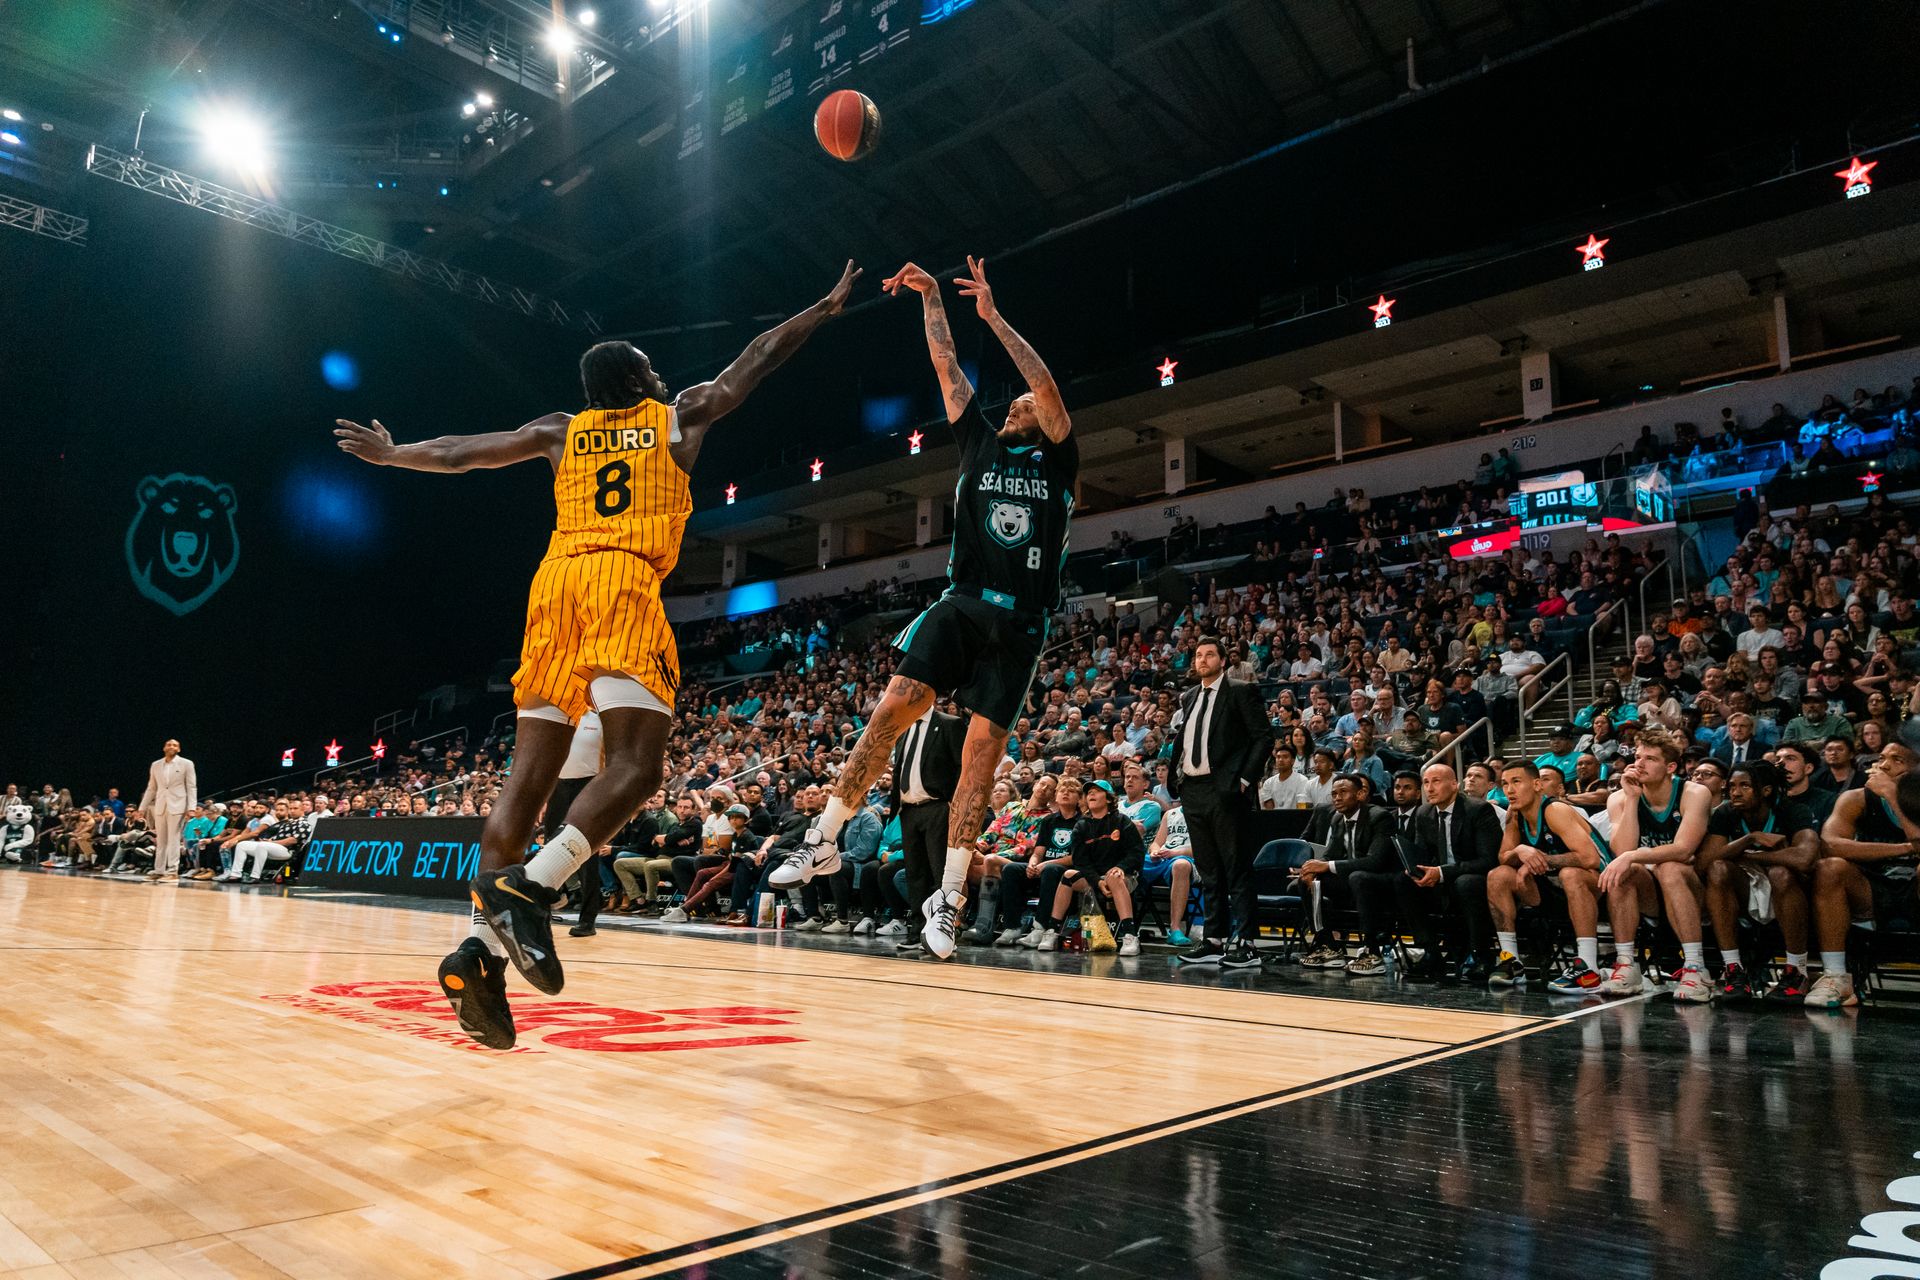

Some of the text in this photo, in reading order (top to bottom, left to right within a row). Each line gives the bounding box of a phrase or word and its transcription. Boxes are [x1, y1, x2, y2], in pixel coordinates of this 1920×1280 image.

[878, 13, 889, 33] 4
[821, 44, 836, 69] 14
[574, 428, 655, 455] ODURO
[1512, 435, 1536, 450] 219
[594, 460, 631, 518] 8
[978, 472, 1049, 500] SEA BEARS
[1522, 534, 1550, 549] 119
[1026, 546, 1042, 570] 8
[304, 839, 481, 882] BETVICTOR BETVI
